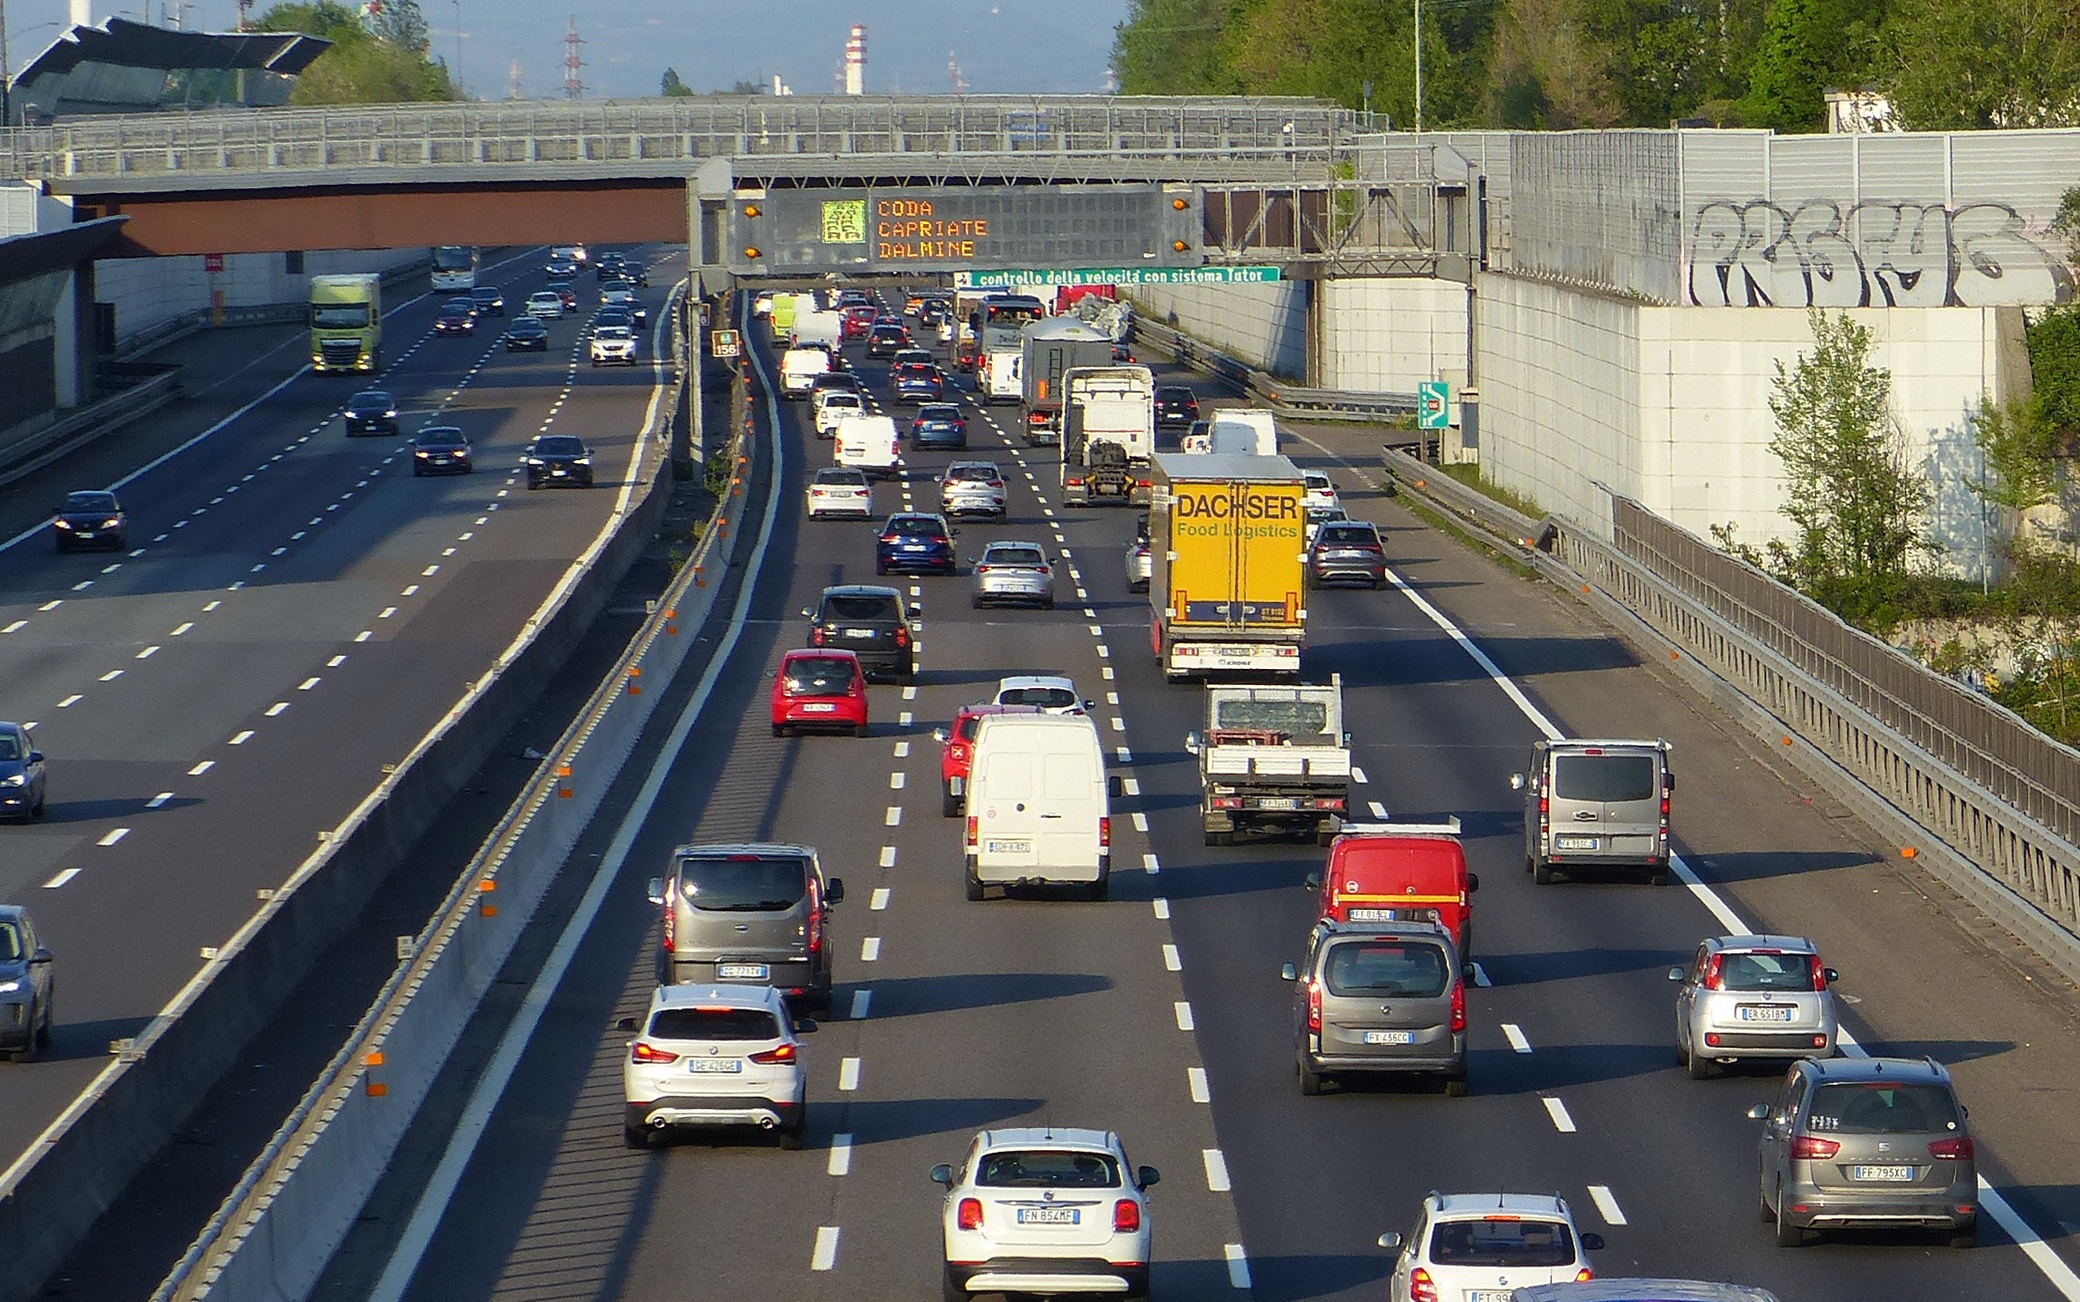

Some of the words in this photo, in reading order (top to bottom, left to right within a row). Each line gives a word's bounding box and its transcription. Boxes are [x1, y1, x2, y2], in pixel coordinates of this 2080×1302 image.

[878, 200, 933, 217] CODA
[878, 220, 988, 238] CAPRIATE
[878, 240, 975, 259] DALMINE
[979, 271, 1042, 286] controllo
[1046, 270, 1082, 285] della
[1144, 272, 1168, 283] con
[1171, 268, 1223, 283] sistema
[1227, 268, 1264, 283] Tutor
[716, 344, 737, 355] 156
[1177, 494, 1298, 520] DACHSER
[1177, 522, 1219, 537] Food
[1223, 522, 1298, 540] Logistics
[1861, 1167, 1874, 1178] FF
[1024, 1209, 1038, 1221] FN
[1040, 1209, 1072, 1221] 854MF
